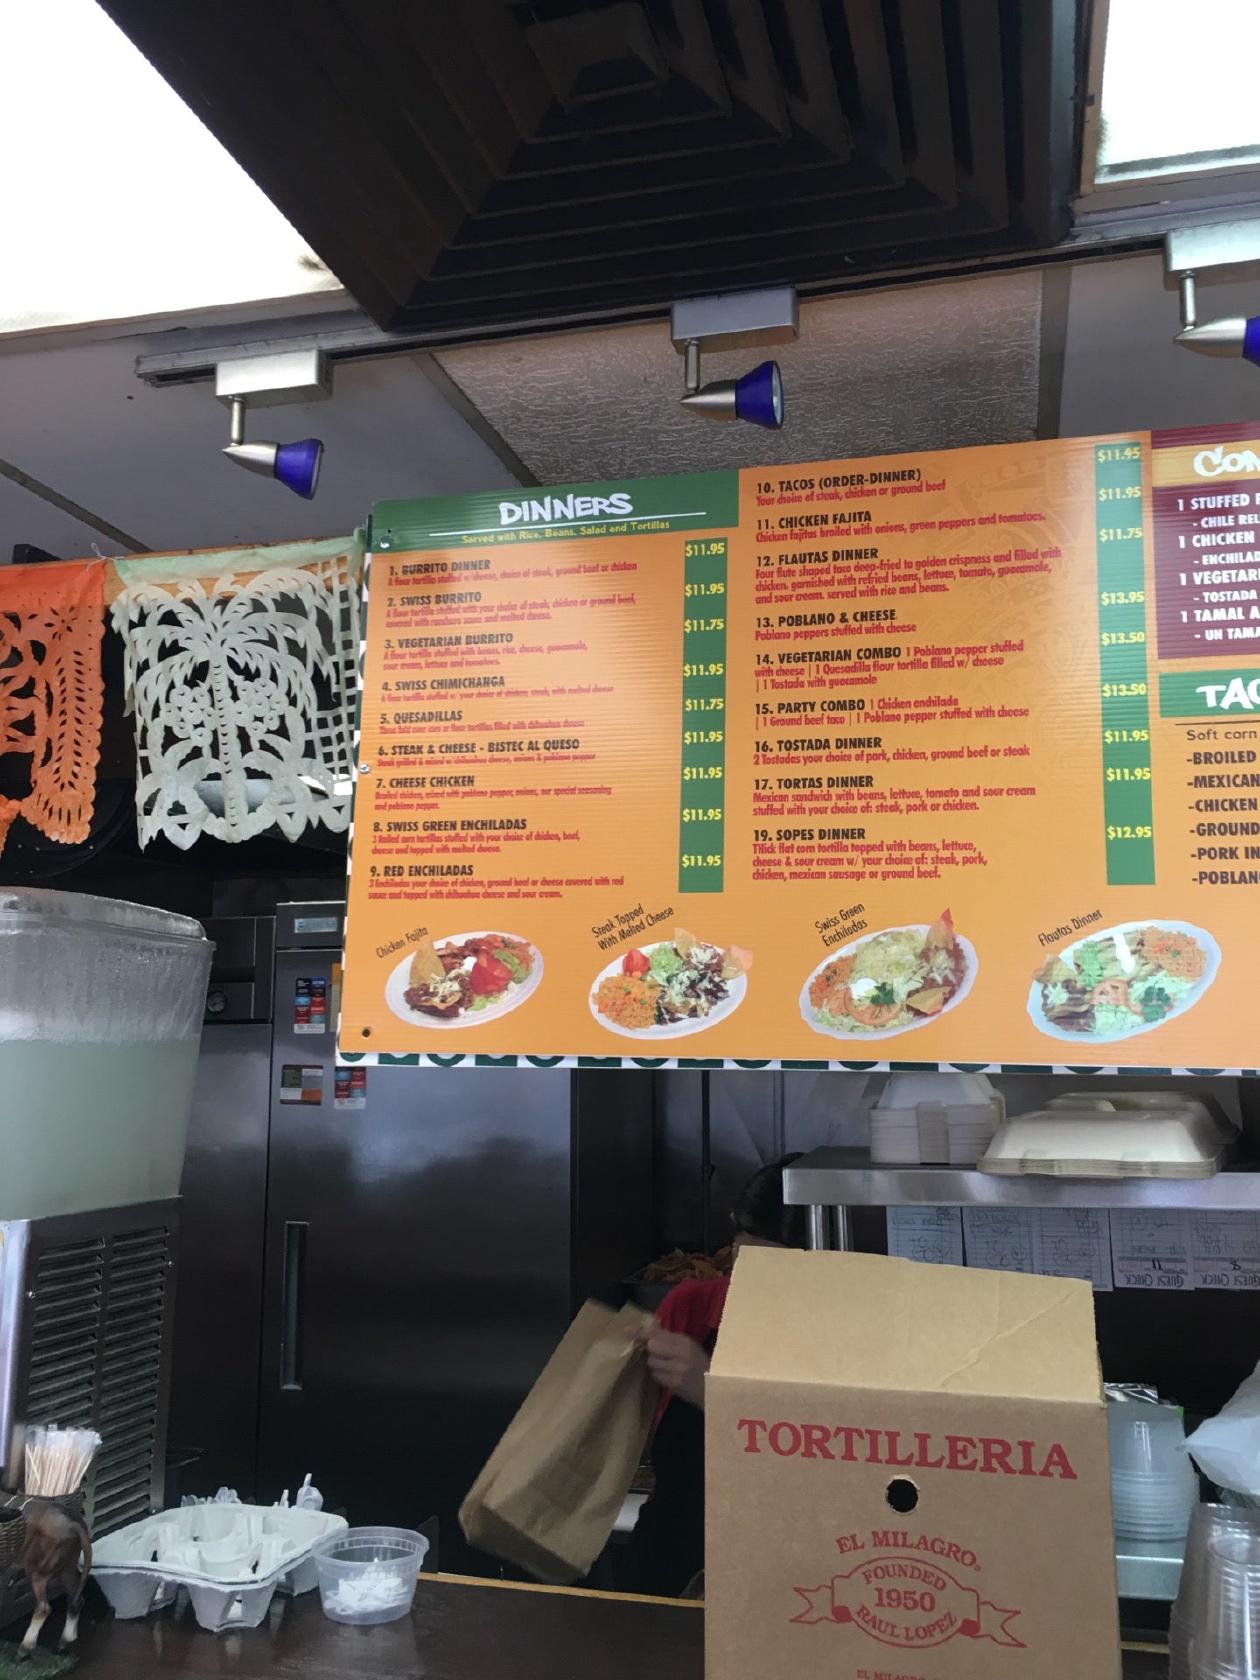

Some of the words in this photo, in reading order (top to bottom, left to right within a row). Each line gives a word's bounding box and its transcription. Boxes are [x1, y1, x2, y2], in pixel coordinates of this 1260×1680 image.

[1097, 448, 1142, 462] $11.95
[757, 482, 774, 493] 10.
[778, 478, 815, 491] TACOS
[818, 469, 921, 488] (ORDER-DINNER)
[1098, 486, 1142, 500] $11.95
[498, 493, 633, 525] DINNERS
[1177, 499, 1183, 511] 1
[1190, 494, 1250, 509] STUFFED
[757, 519, 774, 530] 11.
[778, 514, 828, 528] CHICKEN
[832, 511, 872, 524] FAJITA
[1200, 515, 1235, 527] CHILE
[462, 535, 496, 543] Served
[580, 525, 606, 534] Salad
[609, 523, 627, 532] and
[631, 521, 670, 529] Tortillas
[1099, 526, 1142, 541] $11.75
[1178, 535, 1185, 548] 1
[1192, 531, 1255, 546] CHICKEN
[684, 542, 725, 556] $11.95
[757, 555, 774, 566] 12.
[778, 551, 828, 564] FLAUTAS
[832, 548, 878, 561] DINNER
[389, 566, 398, 576] 1.
[401, 562, 448, 574] BURRITO
[451, 559, 491, 571] DINNER
[1179, 573, 1186, 585] 1
[684, 583, 725, 596] $11.95
[1101, 589, 1145, 605] $13.95
[1202, 589, 1258, 602] TOSTADA
[387, 597, 396, 607] 2.
[399, 595, 432, 605] SWISS
[434, 592, 481, 604] BURRITO
[756, 617, 774, 627] 13.
[778, 613, 835, 626] POBLANO
[839, 612, 849, 623] &
[852, 609, 895, 622] CHEESE
[1180, 610, 1187, 622] 1
[1193, 607, 1245, 621] TAMAL
[684, 618, 726, 632] $11.75
[384, 639, 394, 649] 3.
[397, 636, 461, 648] VEGETARIAN
[465, 633, 513, 644] BURRITO
[1101, 631, 1145, 645] $13.50
[1204, 629, 1223, 640] UN
[756, 654, 773, 664] 14.
[777, 649, 851, 663] VEGETARIAN
[856, 647, 901, 659] COMBO
[684, 663, 726, 676] $11.95
[381, 681, 391, 691] 4.
[395, 680, 427, 690] SWISS
[430, 676, 505, 689] CHIMICHANGA
[1102, 683, 1147, 696] $13.50
[684, 698, 726, 711] $11.75
[755, 703, 773, 714] 15.
[777, 701, 816, 713] PARTY
[820, 699, 865, 711] COMBO
[379, 713, 390, 724] 5.
[393, 710, 463, 723] QUESADILLAS
[683, 731, 724, 743] $11.95
[1104, 727, 1149, 742] $11.95
[1186, 729, 1218, 740] Soft
[1224, 730, 1257, 739] corn
[377, 745, 388, 756] 6.
[391, 745, 423, 755] STEAK
[426, 744, 435, 754] &
[438, 743, 476, 753] CHEESE
[487, 741, 523, 752] BISTEC
[527, 740, 540, 751] AL
[543, 739, 580, 750] QUESO
[754, 741, 773, 752] 16.
[776, 738, 830, 751] TOSTADA
[835, 737, 882, 749] DINNER
[683, 767, 723, 779] $11.95
[1106, 766, 1151, 781] $11.95
[376, 778, 386, 788] 7.
[388, 777, 426, 788] CHEESE
[429, 775, 474, 787] CHICKEN
[754, 778, 772, 789] 17.
[776, 777, 822, 789] TORTAS
[826, 775, 873, 787] DINNER
[682, 808, 721, 821] $11.95
[372, 821, 382, 832] 8.
[386, 821, 418, 831] SWISS
[422, 820, 457, 831] GREEN
[460, 819, 526, 830] ENCHILADAS
[1107, 826, 1152, 839] $12.95
[753, 829, 772, 841] 19.
[776, 829, 814, 840] SOPES
[818, 828, 865, 839] DINNER
[682, 855, 721, 867] $11.95
[370, 865, 380, 876] 9.
[383, 865, 404, 876] RED
[408, 865, 473, 876] ENCHILADAS
[592, 920, 616, 937] Steak
[615, 903, 644, 926] Topped
[815, 917, 840, 933] Swiss
[839, 904, 865, 920] Green
[598, 935, 618, 950] With
[619, 920, 646, 941] Melted
[646, 907, 674, 926] Cheese
[822, 919, 867, 946] Enchiladas
[1038, 925, 1072, 946] Flautas
[1071, 910, 1102, 929] Dinner
[376, 942, 405, 958] Chicken
[405, 928, 428, 943] Fajita
[737, 1419, 1077, 1480] TORTILLERIA
[835, 1534, 864, 1554] EL
[862, 1564, 947, 1591] FOUNDED
[874, 1587, 936, 1612] 1950
[856, 1605, 900, 1639] RAUL
[905, 1612, 957, 1640] LOPEZ
